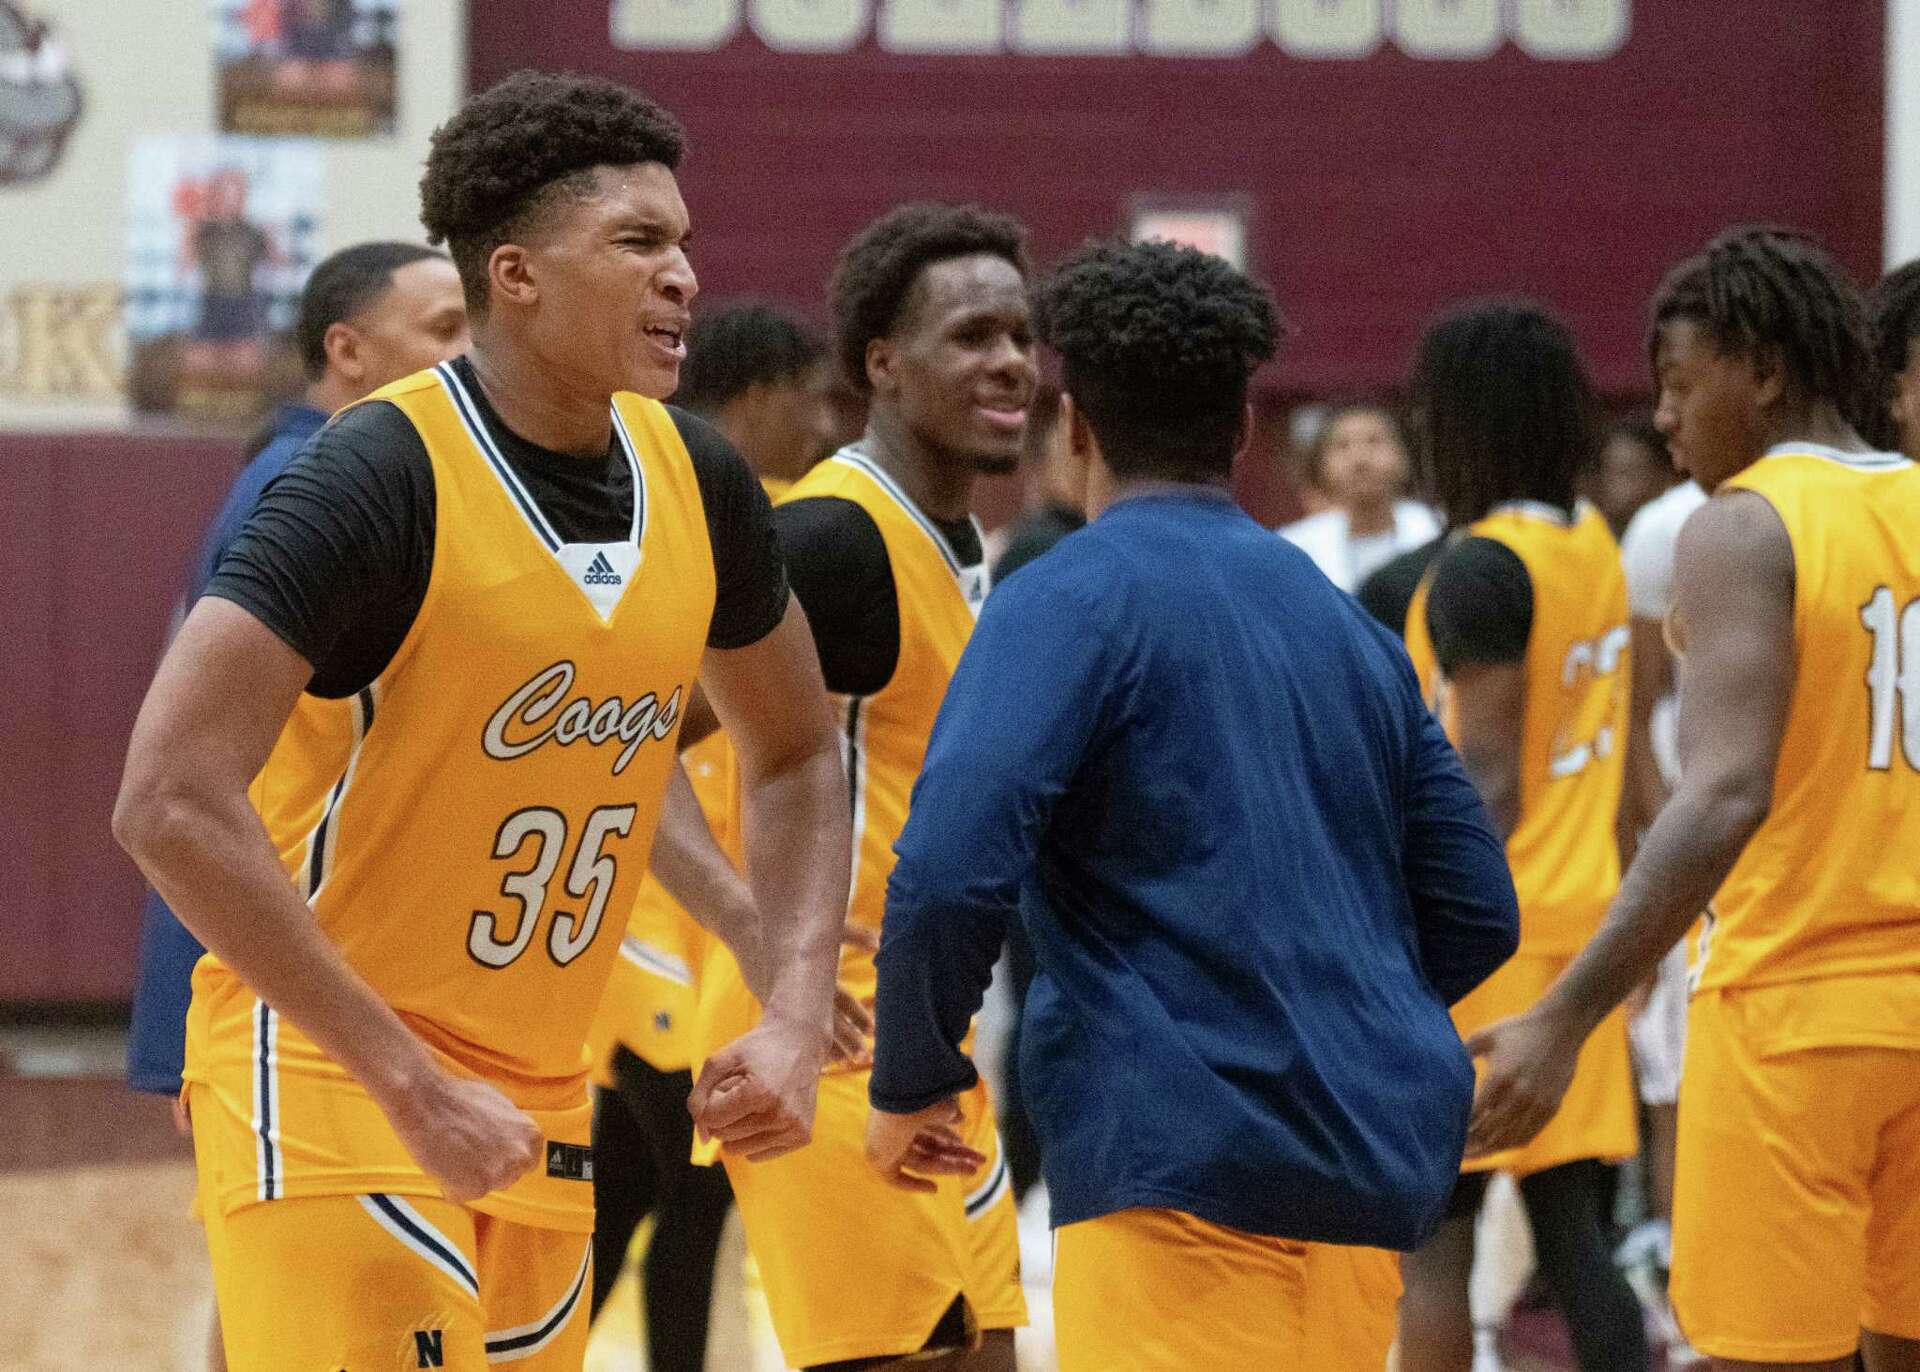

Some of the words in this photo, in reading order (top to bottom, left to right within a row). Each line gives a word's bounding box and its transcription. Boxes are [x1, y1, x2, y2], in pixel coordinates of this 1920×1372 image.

[584, 571, 622, 585] adidas
[481, 659, 683, 776] Coogs
[466, 802, 637, 970] 35
[414, 1329, 443, 1368] N
